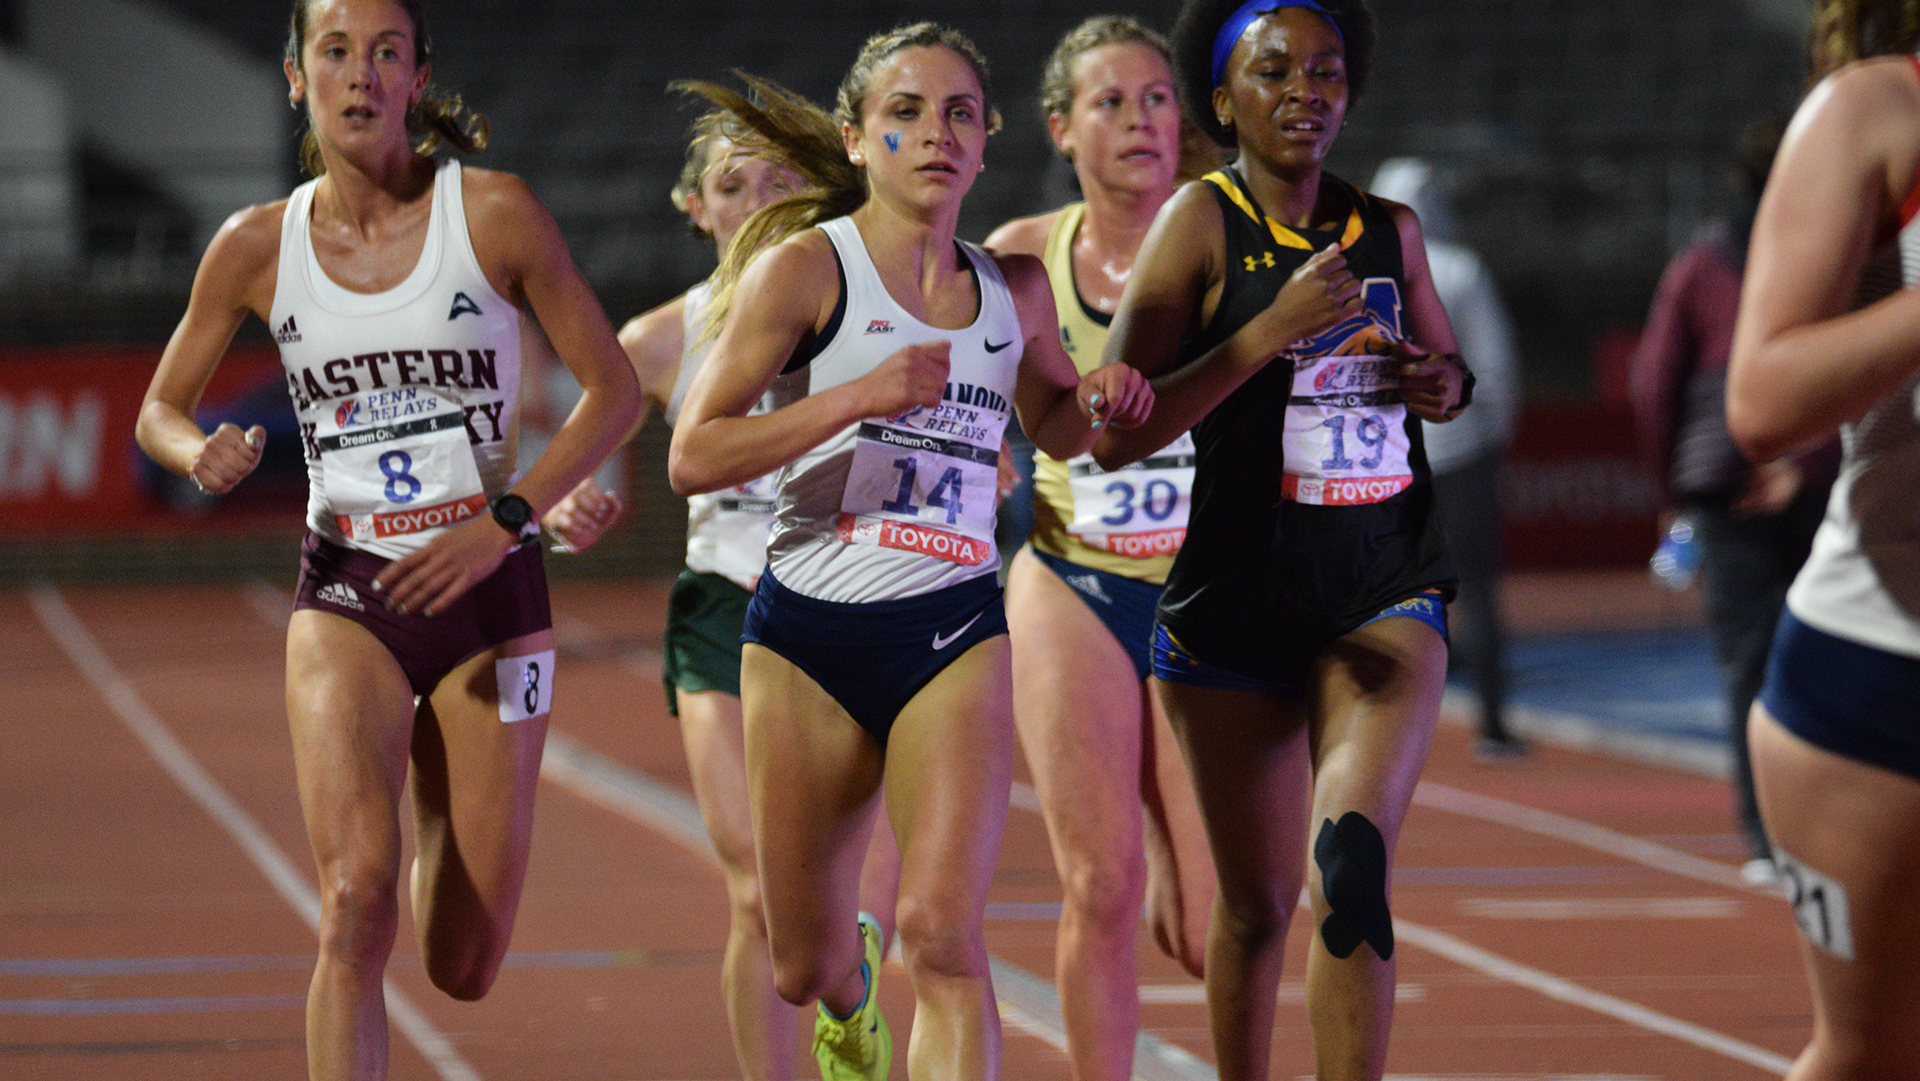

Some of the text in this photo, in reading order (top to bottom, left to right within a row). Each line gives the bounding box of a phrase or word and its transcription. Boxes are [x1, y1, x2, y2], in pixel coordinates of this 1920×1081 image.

[870, 319, 891, 327] BIG
[289, 350, 499, 411] EASTERN
[368, 387, 417, 408] PENN
[371, 397, 438, 421] RELAYS
[931, 405, 980, 424] PENN
[339, 433, 375, 448] Dream
[881, 429, 921, 448] Dream
[924, 418, 988, 441] RELAYS
[1321, 414, 1388, 470] 19
[378, 450, 422, 504] 8
[881, 457, 963, 524] 14
[1101, 478, 1178, 526] 30
[1330, 480, 1402, 501] TOYOTA
[378, 503, 472, 534] TOYOTA
[887, 524, 976, 561] TOYOTA
[1110, 530, 1183, 554] TOYOT
[316, 588, 366, 612] adidas
[524, 661, 540, 715] 8
